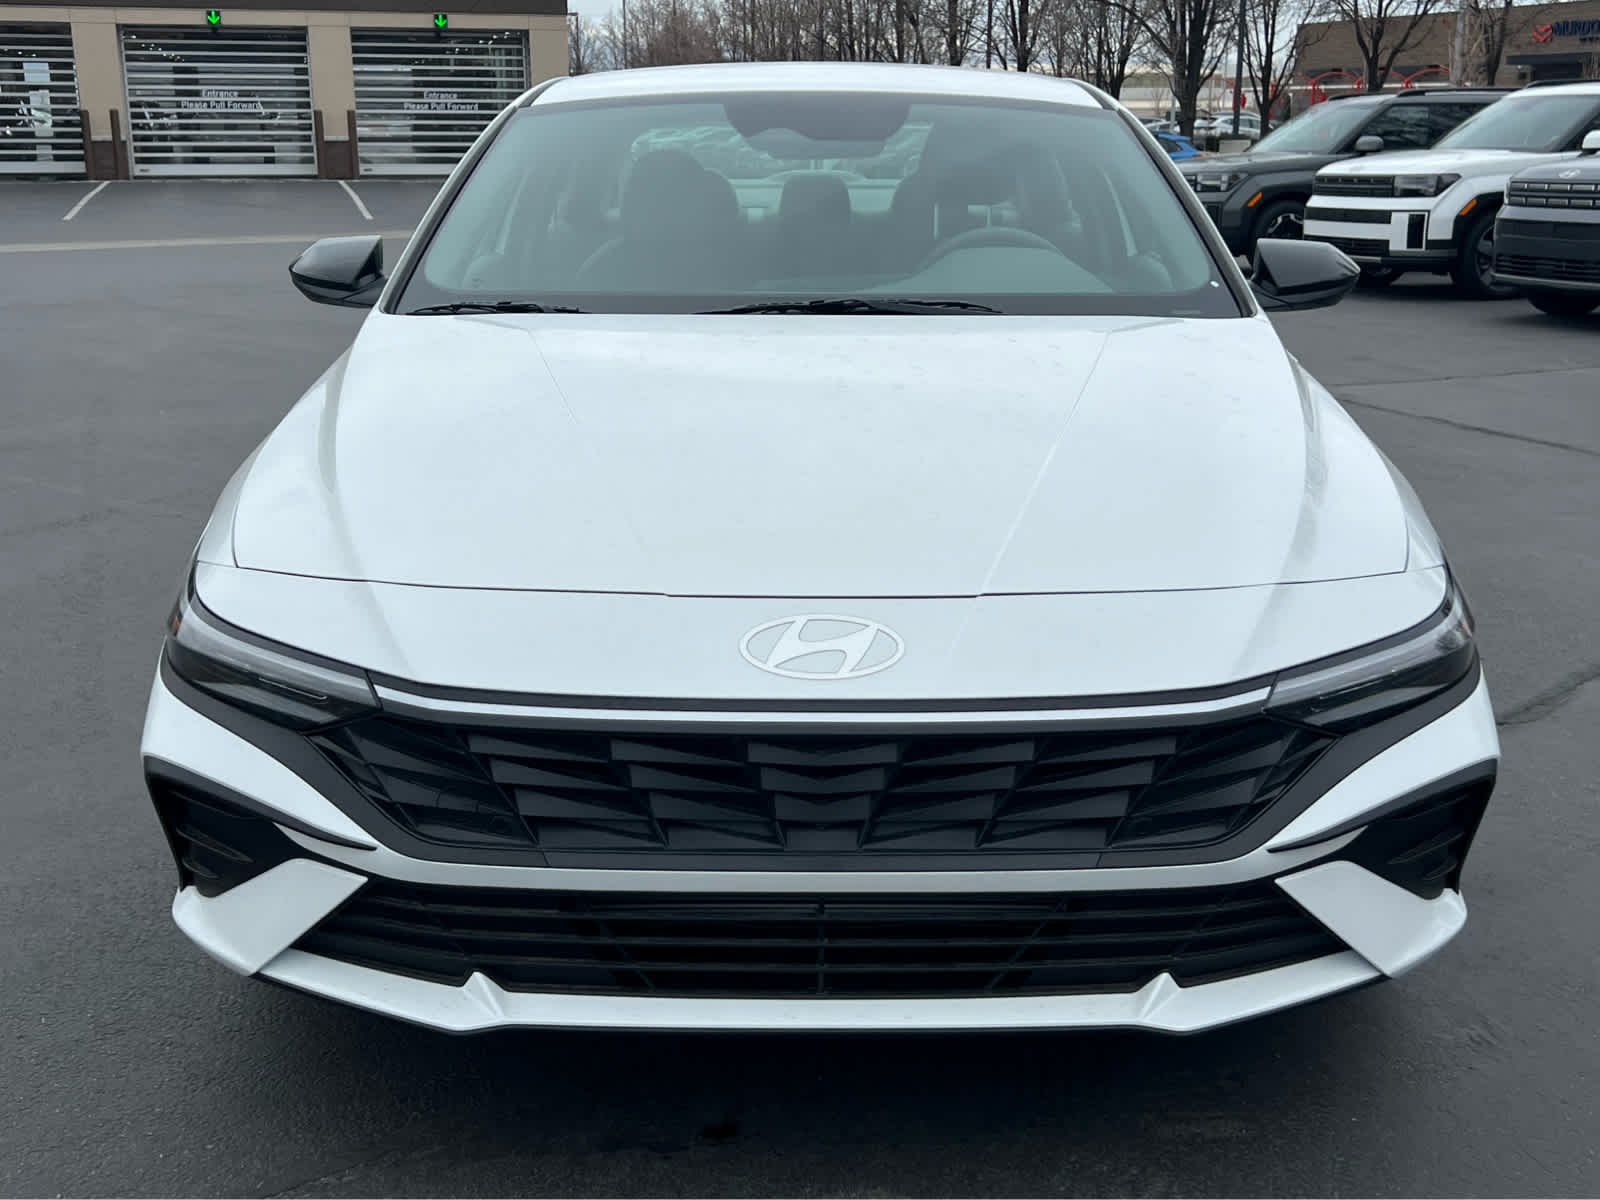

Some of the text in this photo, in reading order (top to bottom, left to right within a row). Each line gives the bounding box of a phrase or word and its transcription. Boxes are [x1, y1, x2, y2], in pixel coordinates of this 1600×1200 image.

[202, 88, 238, 98] Entrance
[424, 90, 458, 100] Entrance
[181, 100, 261, 111] Please Pull Forward
[403, 102, 479, 112] Please Pull Forward
